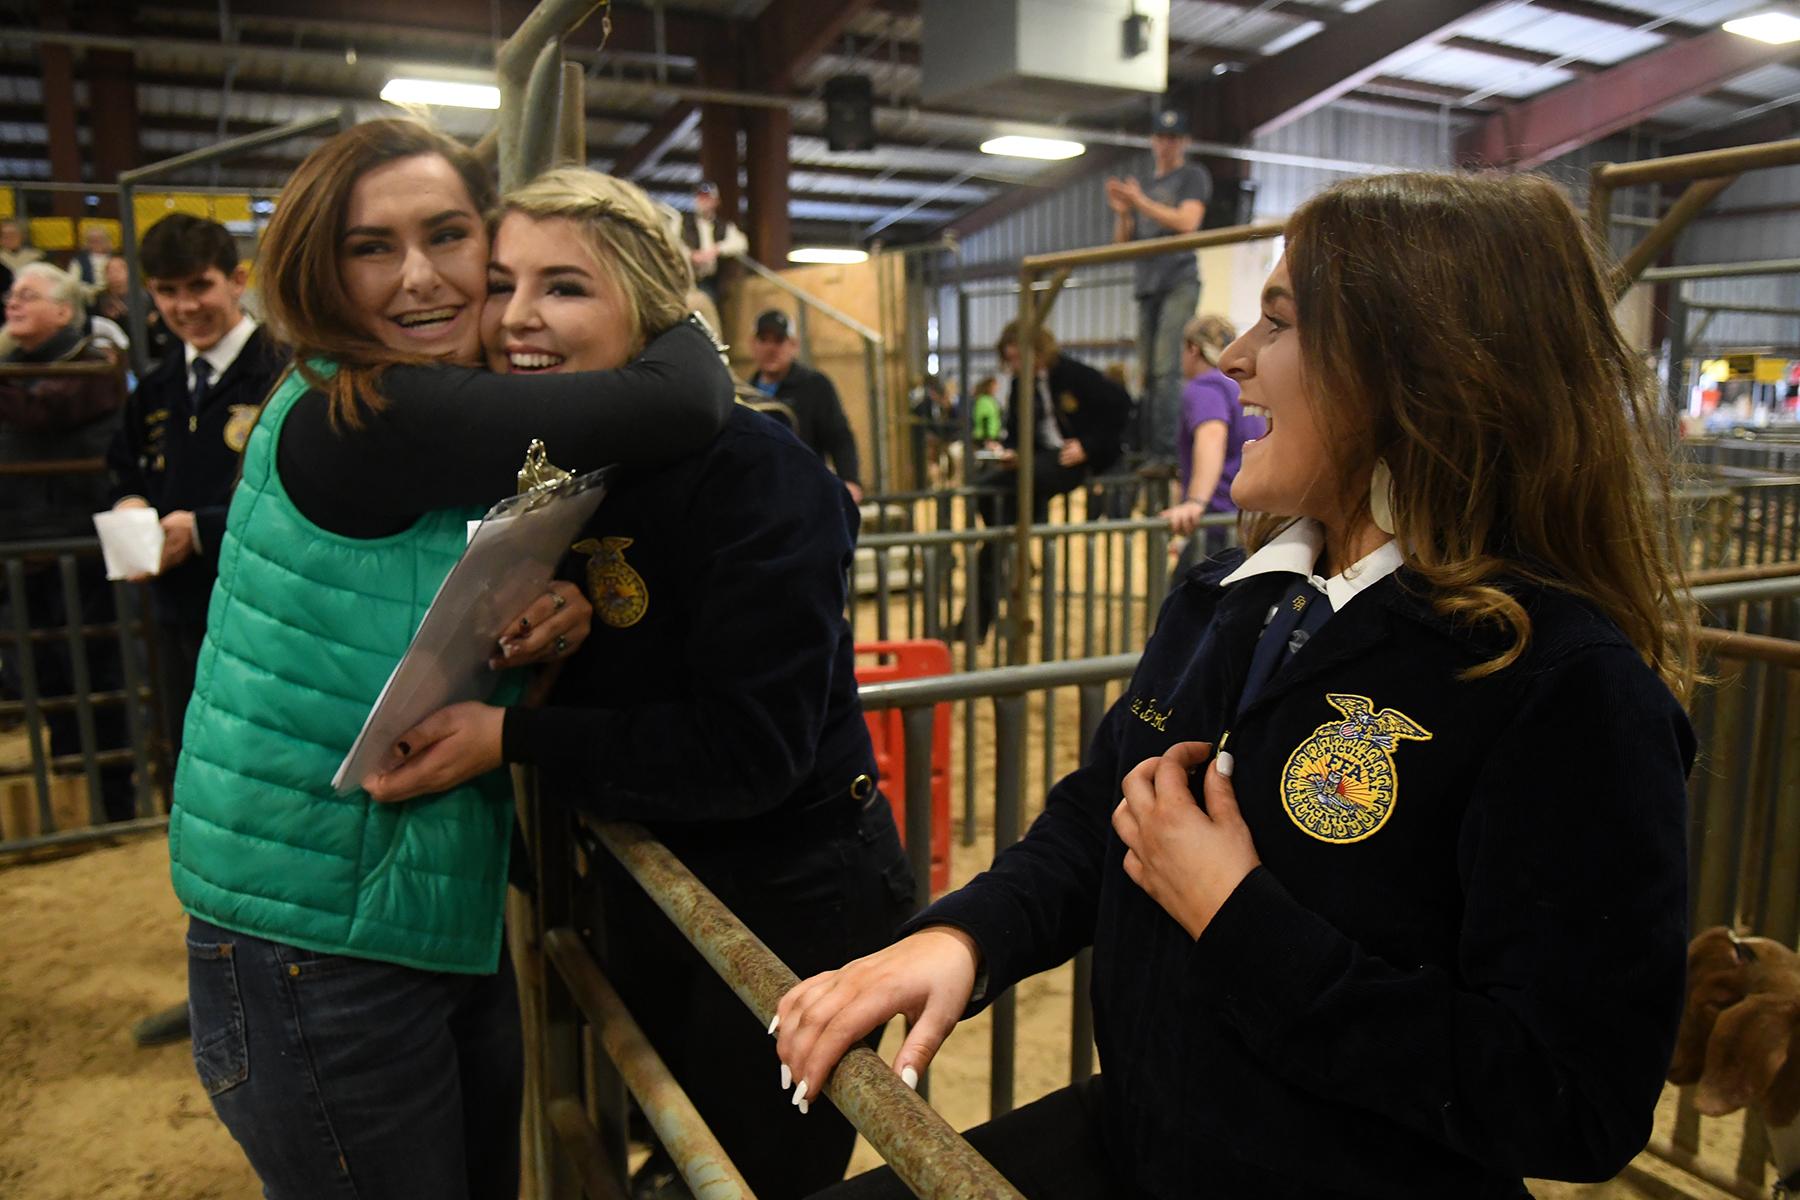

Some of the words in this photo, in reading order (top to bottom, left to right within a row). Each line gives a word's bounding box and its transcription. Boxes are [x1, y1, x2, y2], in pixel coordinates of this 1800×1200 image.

[1309, 745, 1377, 792] AGRICULTURAL
[1325, 753, 1362, 782] FFA
[1300, 788, 1360, 824] EDUCATION
